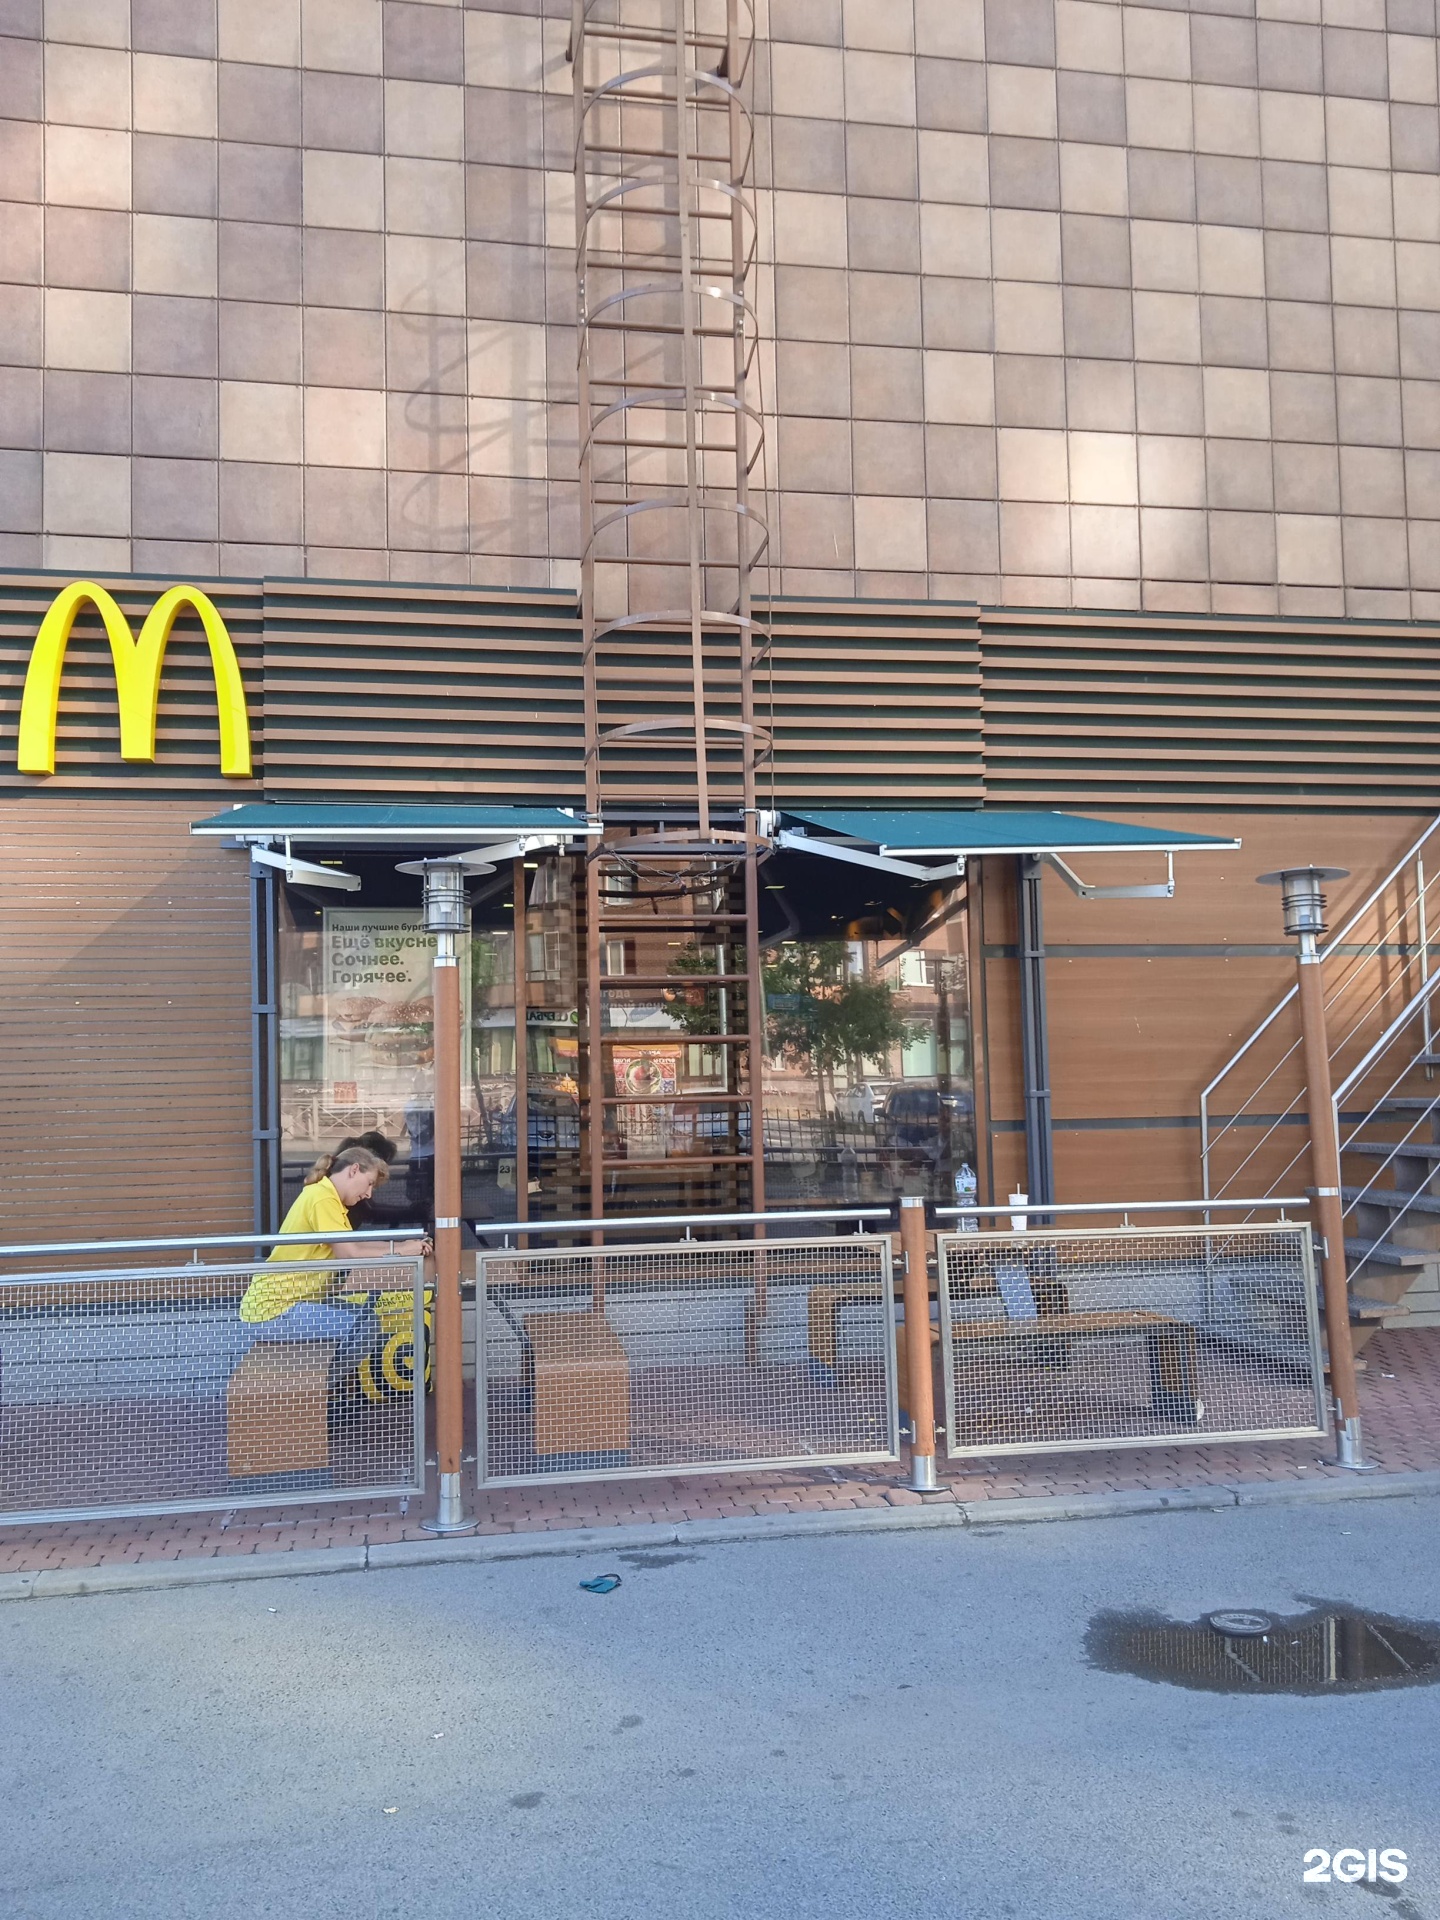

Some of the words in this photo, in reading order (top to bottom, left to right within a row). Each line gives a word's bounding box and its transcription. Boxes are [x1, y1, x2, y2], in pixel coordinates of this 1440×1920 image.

[361, 924, 399, 933] лучшие
[331, 935, 370, 950] Ещё
[331, 952, 404, 966] Сочнее.
[332, 970, 412, 987] Горячее.
[499, 1165, 511, 1174] 23
